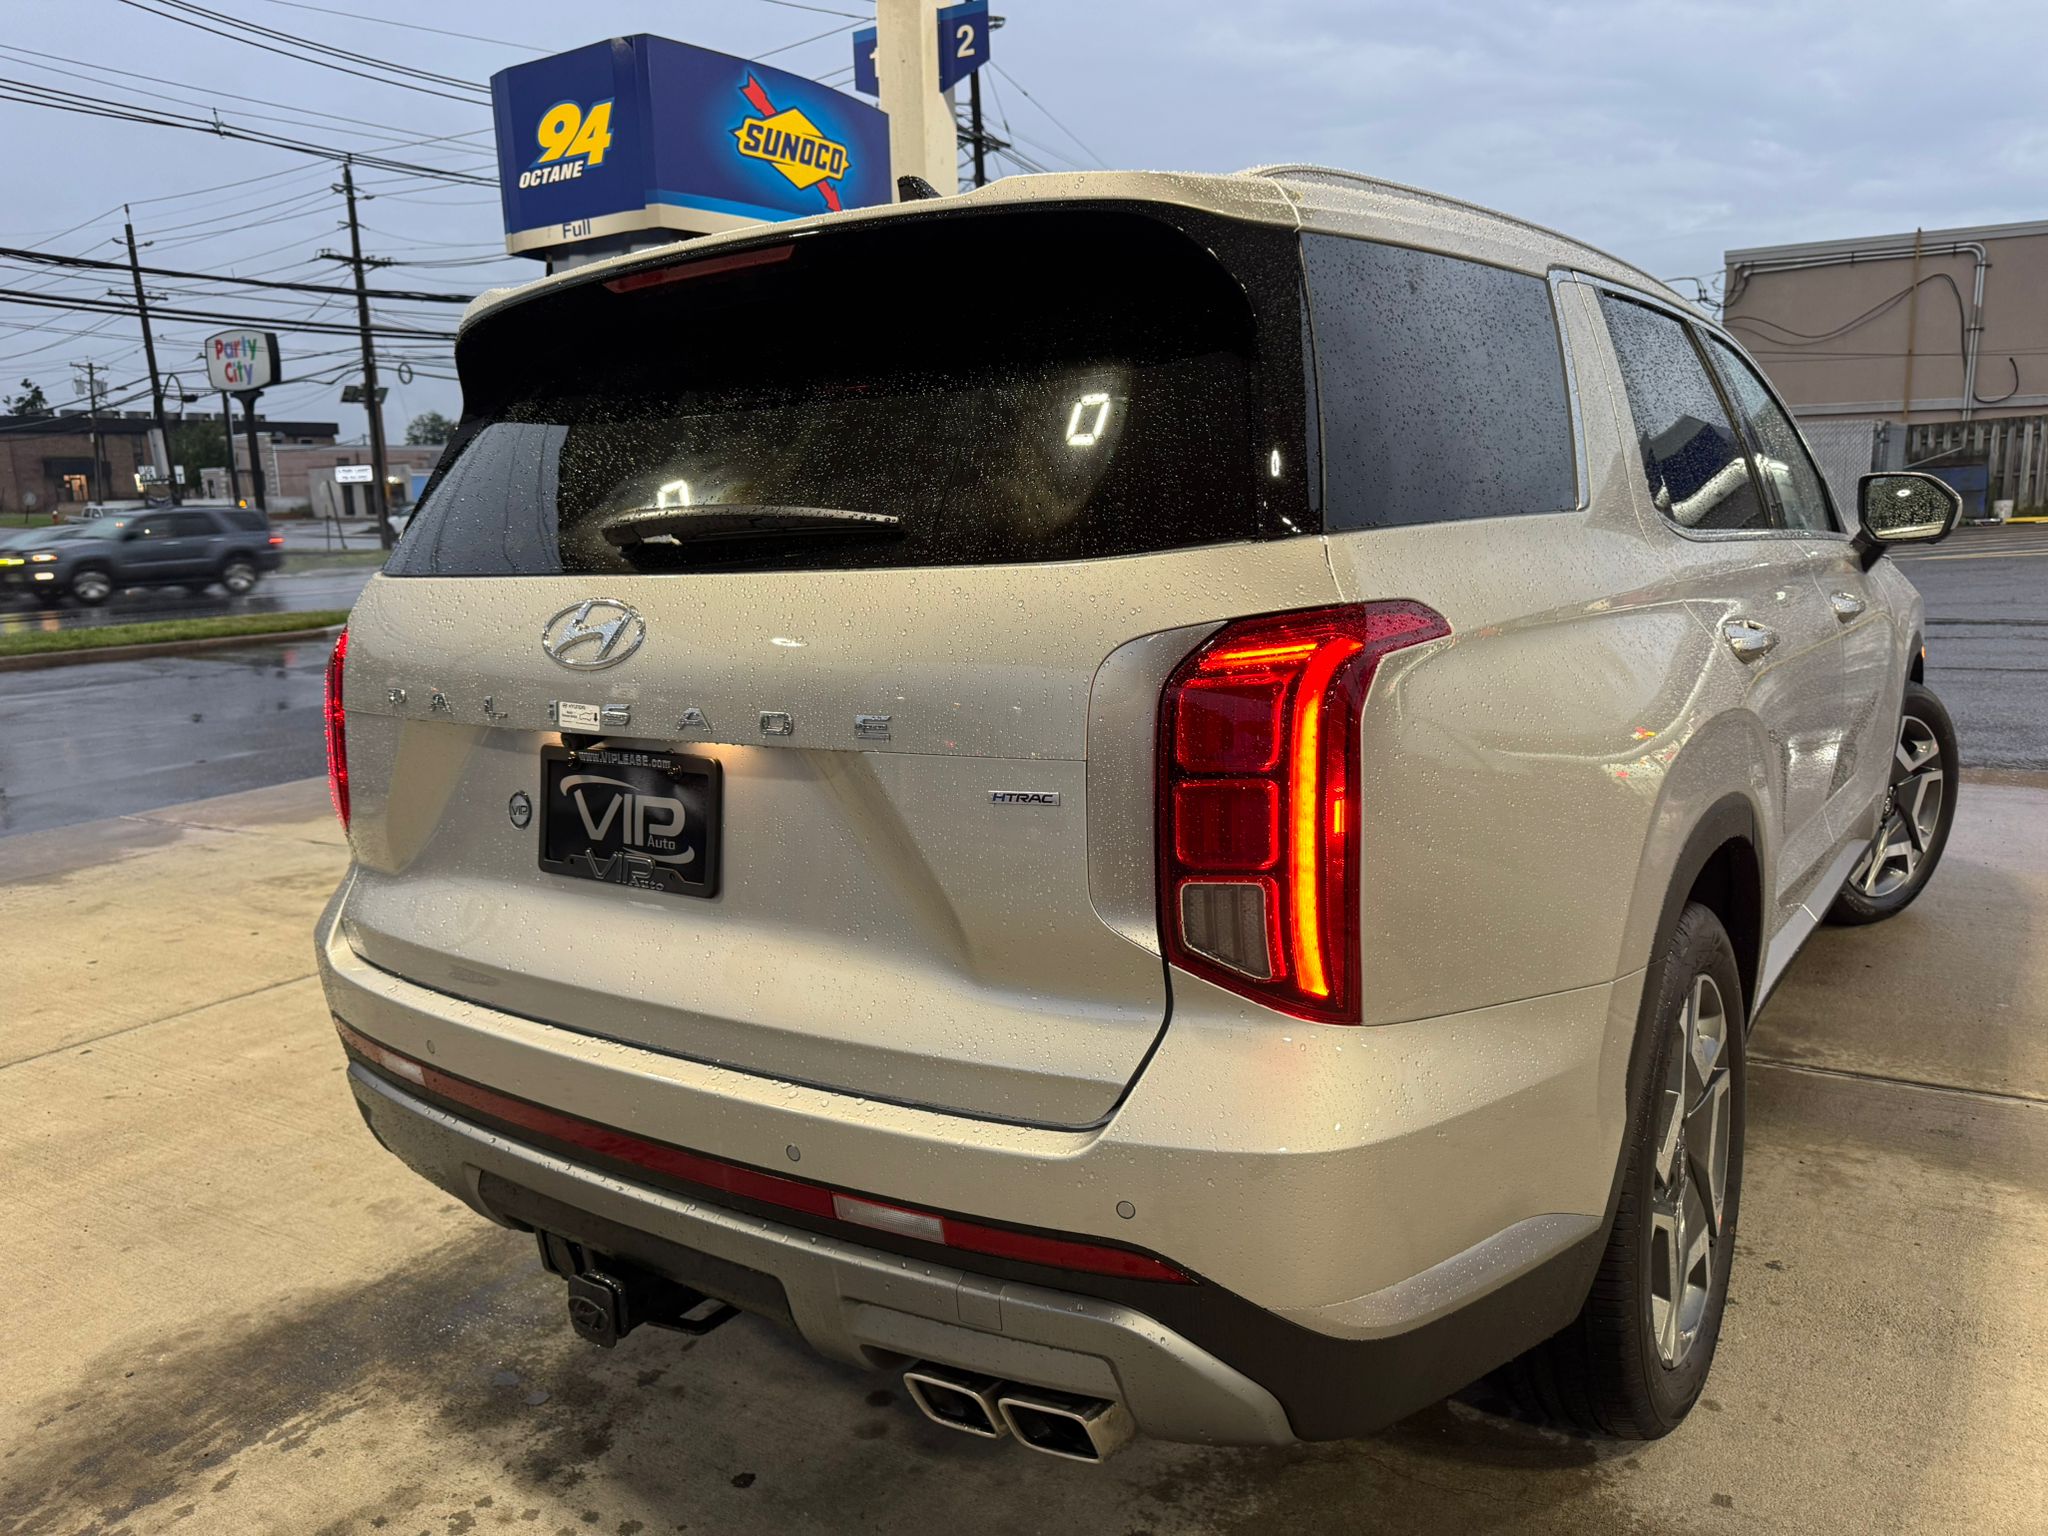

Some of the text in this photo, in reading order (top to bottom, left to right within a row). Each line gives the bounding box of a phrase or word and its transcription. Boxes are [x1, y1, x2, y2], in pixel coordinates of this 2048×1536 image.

[956, 24, 975, 58] 2
[537, 101, 612, 166] 94
[743, 124, 847, 178] SUNOCO
[518, 160, 585, 189] OCTANE
[562, 219, 592, 239] Full
[214, 336, 257, 361] Party
[224, 361, 253, 385] City
[511, 805, 529, 816] VIP
[992, 793, 1054, 804] HTRAC
[573, 788, 686, 847] VIP
[647, 834, 676, 851] Auto
[584, 847, 656, 884] VIP
[627, 874, 665, 891] Auto
